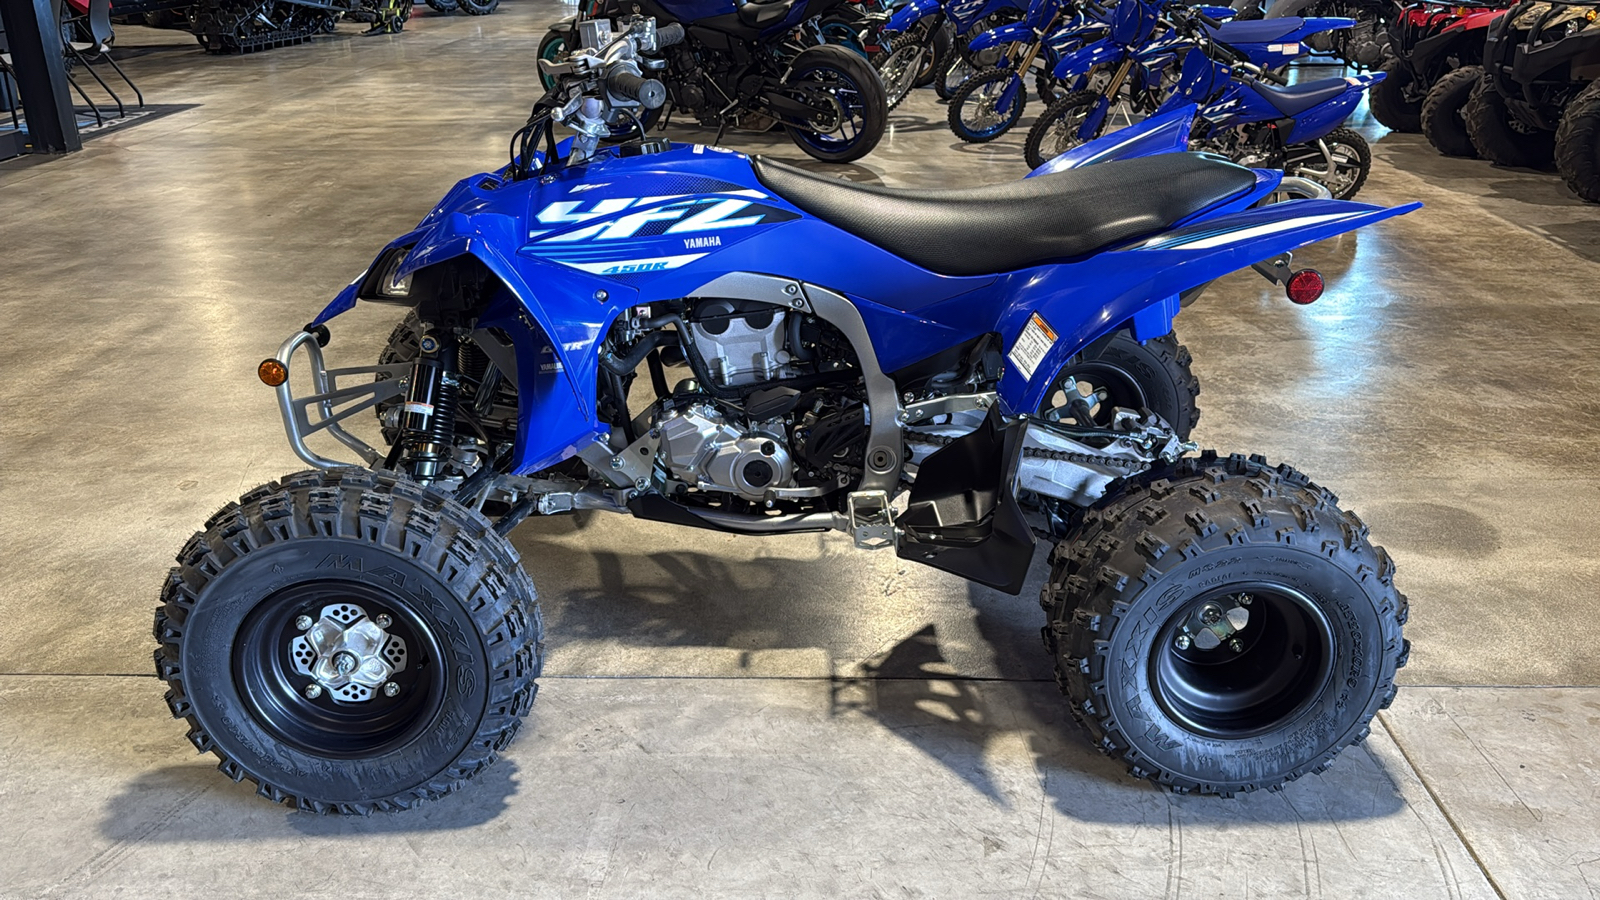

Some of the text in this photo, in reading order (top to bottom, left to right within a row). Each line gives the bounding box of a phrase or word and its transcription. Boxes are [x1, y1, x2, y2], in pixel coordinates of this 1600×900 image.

[529, 192, 767, 243] YFZ
[683, 235, 722, 249] YAMAHA
[602, 261, 669, 275] 450R
[315, 553, 477, 699] MAXXIS
[1120, 583, 1185, 752] MAXXIS
